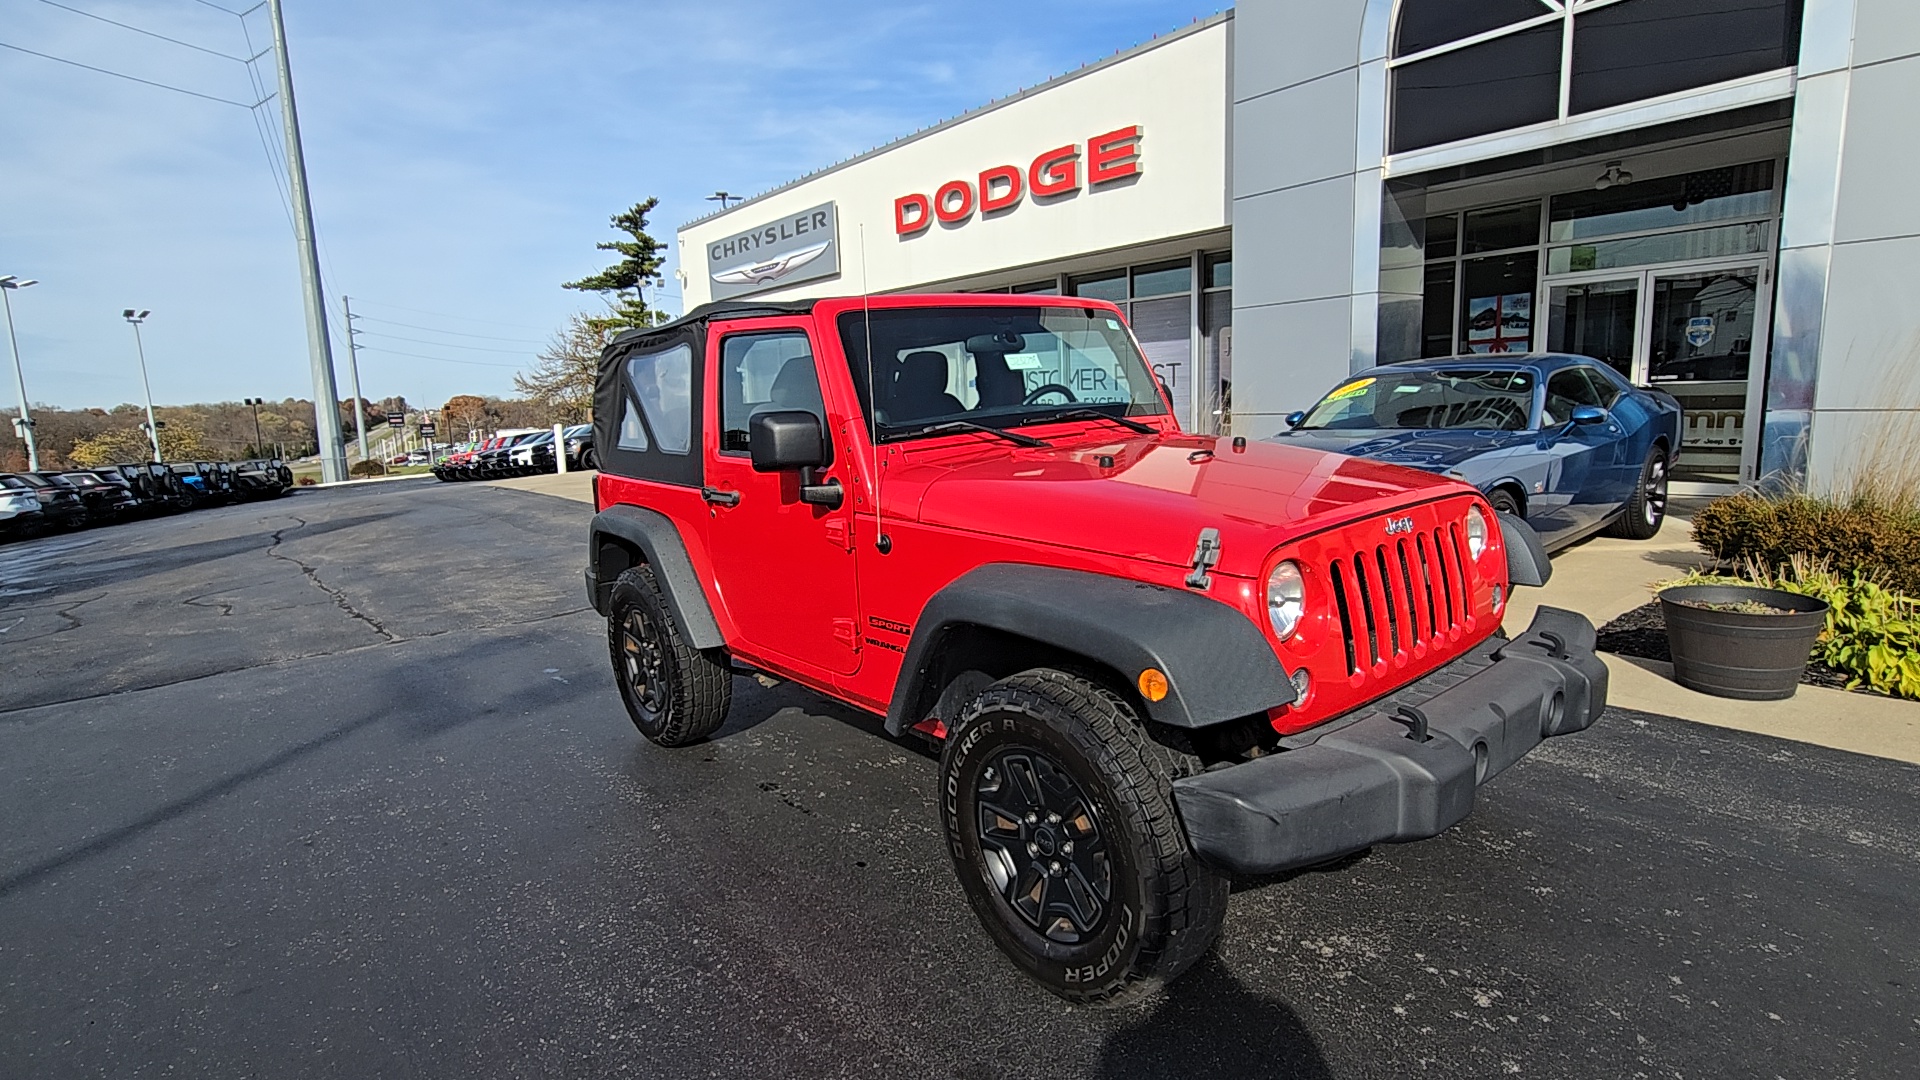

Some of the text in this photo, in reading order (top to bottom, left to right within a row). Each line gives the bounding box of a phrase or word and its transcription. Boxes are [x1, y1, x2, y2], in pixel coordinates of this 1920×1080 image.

[894, 125, 1142, 235] DODGE
[711, 210, 827, 261] CHRYSLER
[1384, 516, 1414, 535] Jeep
[865, 636, 907, 654] WRANGL
[870, 618, 909, 634] SPORT
[947, 720, 995, 860] DISCOVERER
[1064, 903, 1133, 982] COOPER
